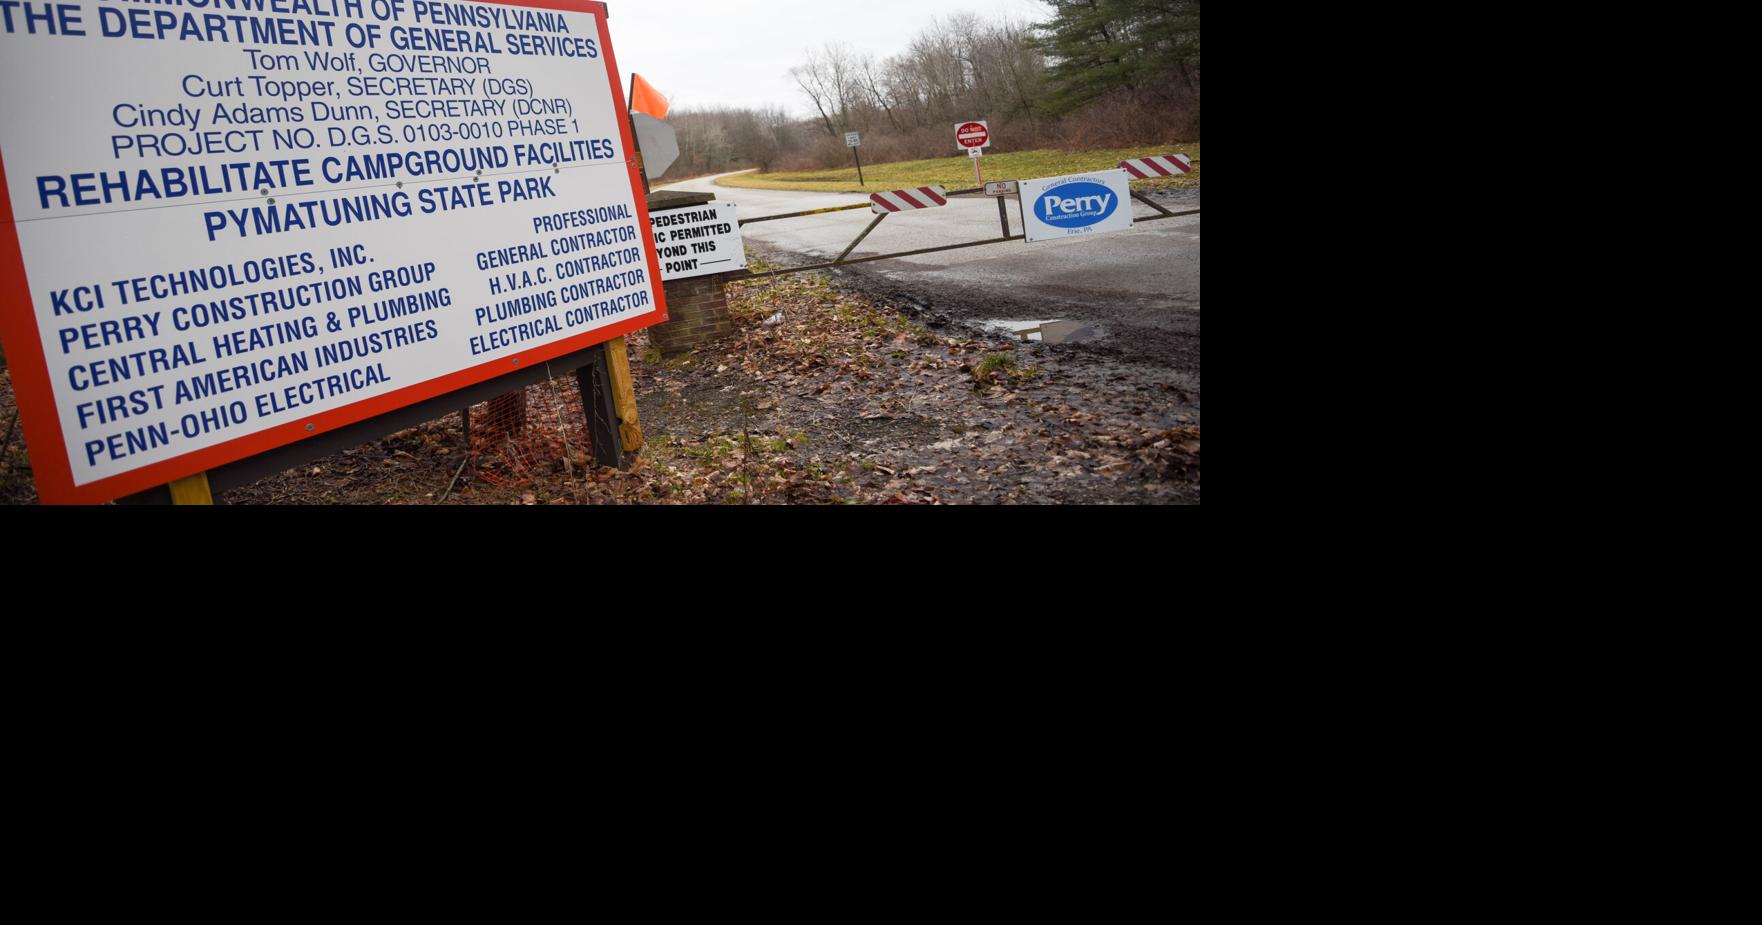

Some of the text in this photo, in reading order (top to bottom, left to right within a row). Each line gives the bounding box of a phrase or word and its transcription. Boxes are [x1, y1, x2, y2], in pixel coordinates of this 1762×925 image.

[0, 0, 598, 59] THE DEPARTMENT OF GENERAL SERVICES
[371, 0, 405, 21] OF
[413, 0, 569, 33] PENNSYLVANIA
[243, 49, 491, 75] Tom Wolf, GOVERNOR
[182, 75, 534, 101] Curt Topper, SECRETARY (DGS)
[112, 97, 573, 131] Cindy Adams Dunn, SECRETARY (DCNR)
[111, 118, 579, 159] PROJECT NO. D.G.S. 0103-0010 PHASE 1
[36, 138, 615, 209] REHABILITATE CAMPGROUND FACILITIES
[1042, 176, 1105, 191] General Contractors
[203, 176, 556, 242] PYMATUNING STATE PARK
[533, 203, 632, 234] PROFESSIONAL
[649, 209, 717, 227] PEDESTRIAN
[1044, 193, 1111, 215] Perry
[1045, 212, 1080, 221] Construction
[476, 225, 637, 270] GENERAL CONTRACTOR
[656, 241, 716, 259] YOND THIS
[670, 223, 731, 241] PERMITTED
[50, 244, 374, 316] KCI TECHNOLOGIES, INC.
[488, 247, 641, 295] H.V.A.C. CONTRACTOR
[666, 259, 698, 273] POINT
[58, 261, 436, 354] PERRY CONSTRUCTION GROUP
[475, 268, 645, 326] PLUMBING CONTRACTOR
[68, 287, 451, 391] CENTRAL HEATING & PLUMBING
[469, 290, 649, 355] ELECTRICAL CONTRACTOR
[76, 319, 438, 429] FIRST AMERICAN INDUSTRIES
[85, 363, 391, 466] PENN-OHIO ELECTRICAL
